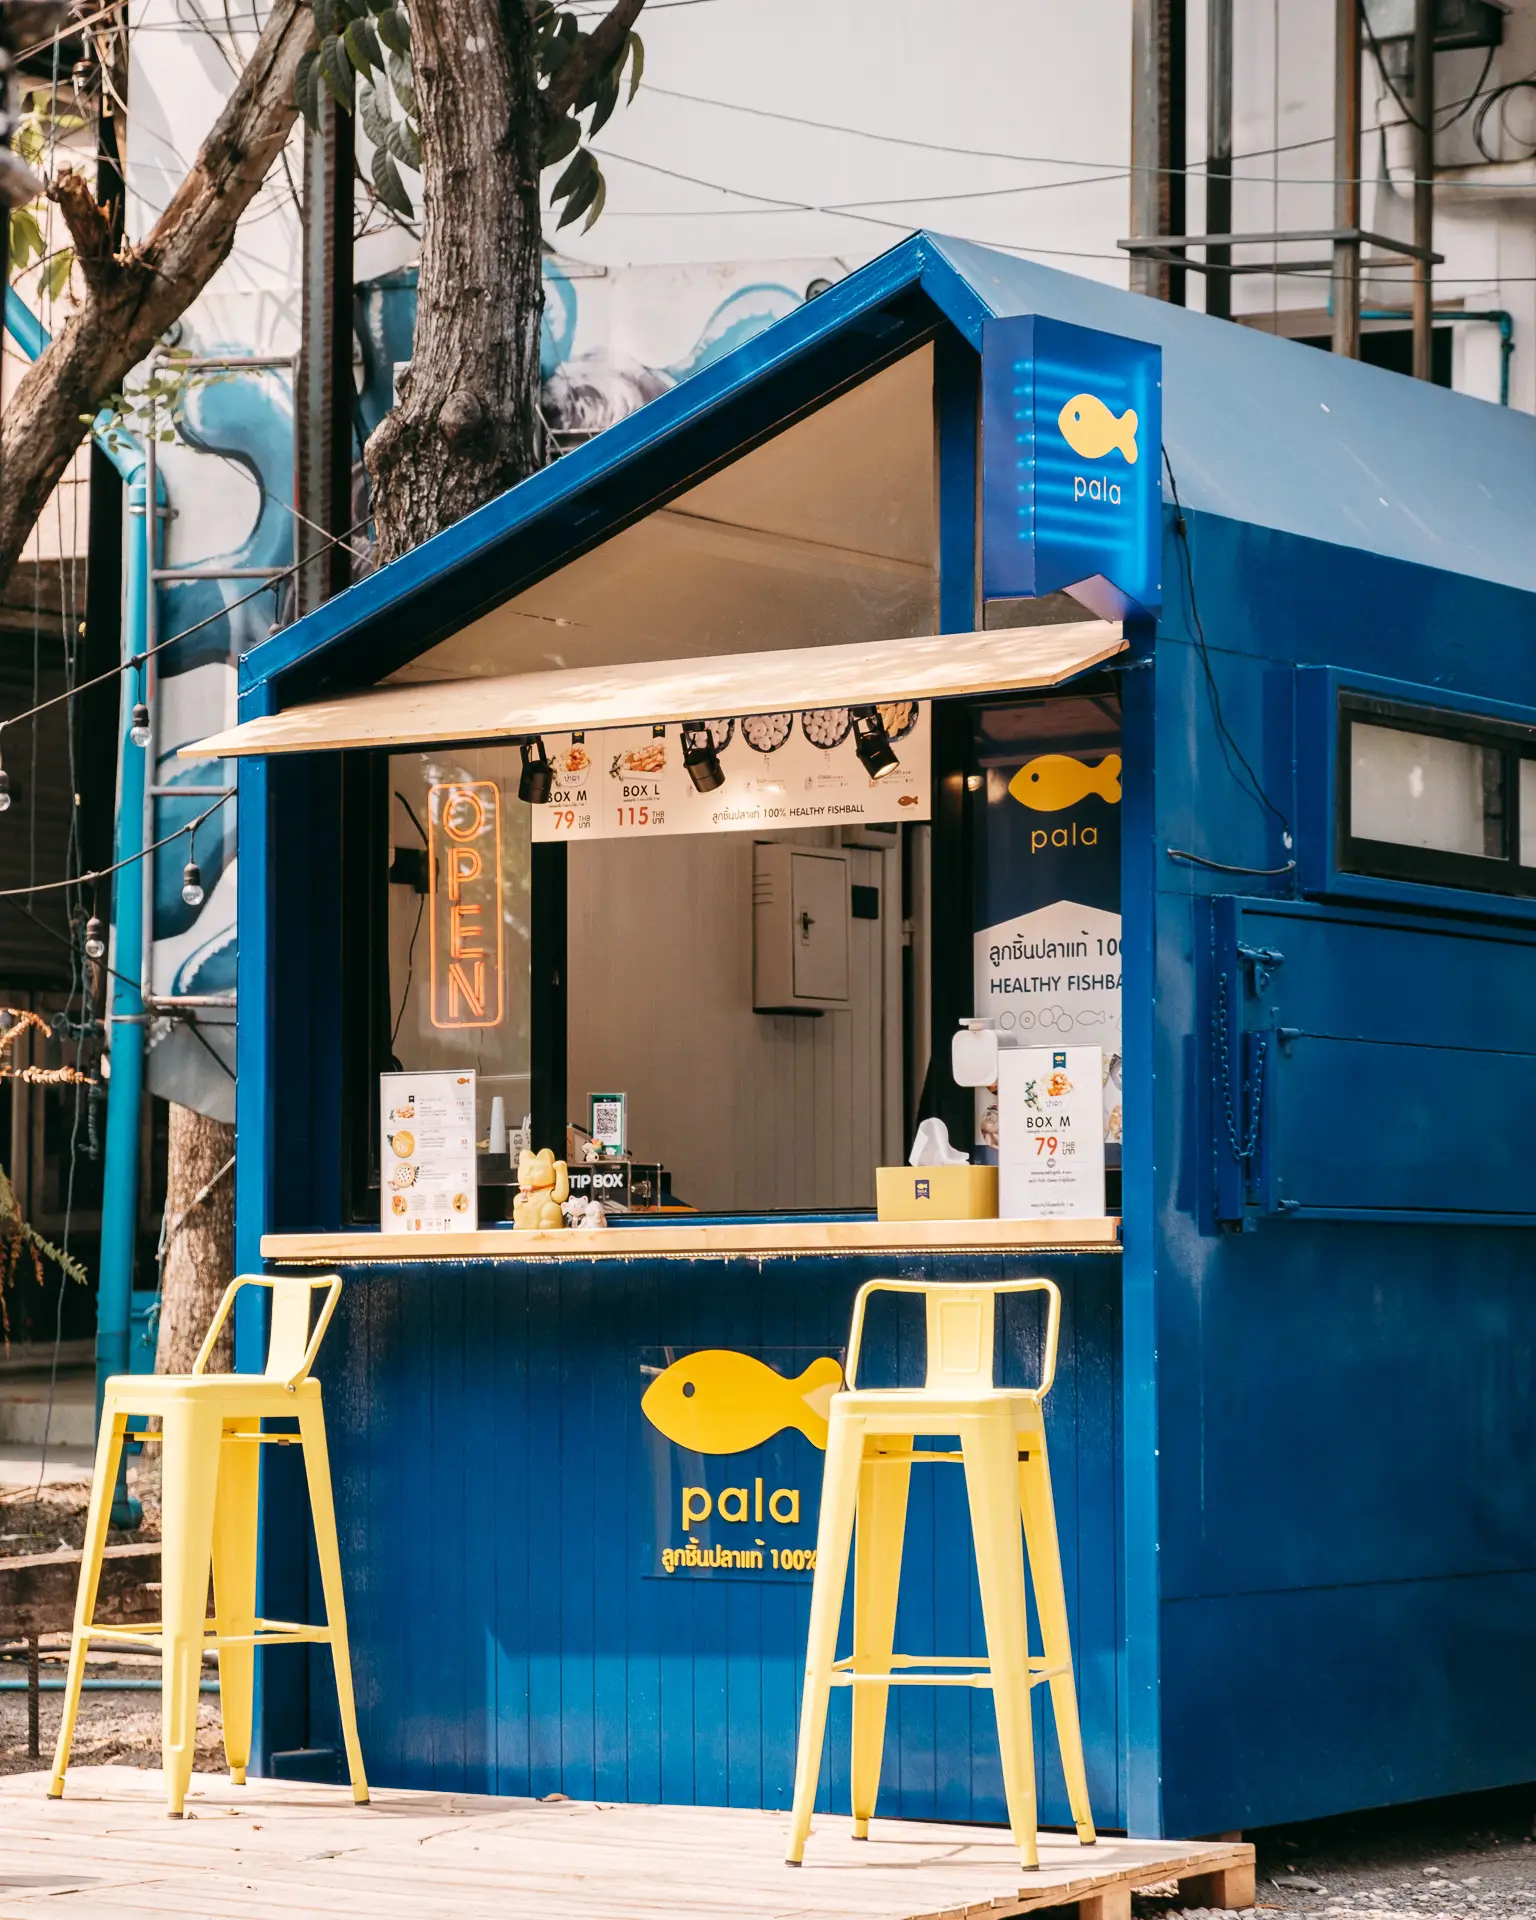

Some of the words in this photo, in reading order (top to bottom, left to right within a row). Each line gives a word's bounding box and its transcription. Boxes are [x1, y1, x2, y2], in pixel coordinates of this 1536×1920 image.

[1074, 476, 1121, 506] pala
[576, 790, 587, 801] M
[623, 785, 648, 797] BOX
[654, 784, 660, 795] L
[554, 810, 575, 830] 79
[617, 806, 649, 826] 115
[652, 810, 665, 818] THB
[763, 807, 787, 818] 100%
[789, 806, 825, 817] HEALTHY
[827, 804, 865, 815] FISHBALL
[1032, 822, 1097, 854] pala
[443, 790, 485, 1018] OPEN
[989, 930, 1089, 967] ลูกชิ้นปลาแท้
[990, 976, 1061, 994] HEALTHY
[1026, 1116, 1053, 1128] BOX
[1060, 1115, 1071, 1127] M
[1035, 1136, 1058, 1156] 79
[1062, 1141, 1075, 1149] THB
[568, 1174, 591, 1189] TIP
[592, 1173, 624, 1188] BOX
[682, 1477, 800, 1531] pala
[661, 1536, 766, 1573] ลูกชิ้นปลาแท้
[771, 1549, 818, 1571] 100%
